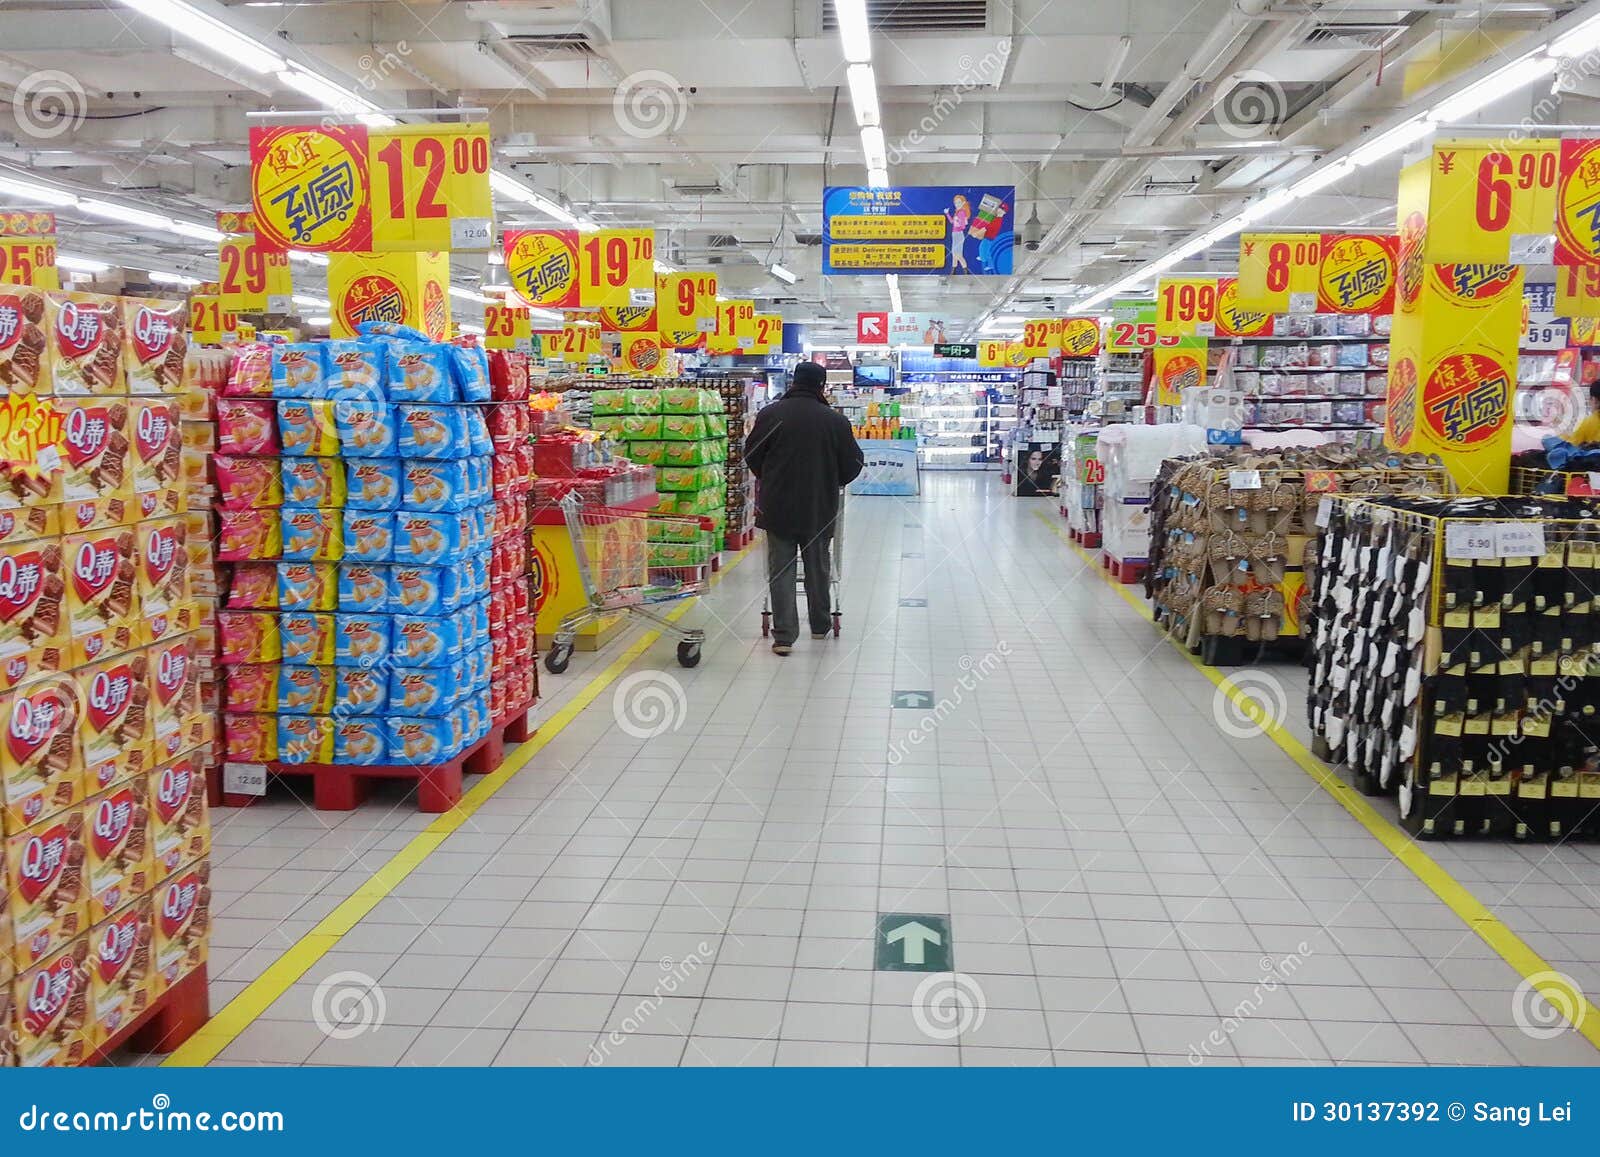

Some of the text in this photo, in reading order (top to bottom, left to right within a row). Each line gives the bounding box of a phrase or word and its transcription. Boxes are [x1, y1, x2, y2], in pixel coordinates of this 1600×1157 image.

[268, 134, 320, 177] 便宜
[1163, 284, 1216, 322] 199
[57, 301, 99, 349] Q蒂
[66, 407, 105, 454] Q蒂
[138, 407, 168, 449] Q蒂
[76, 542, 115, 587] Q蒂
[148, 529, 175, 571] Q蒂
[91, 672, 129, 715] Q蒂
